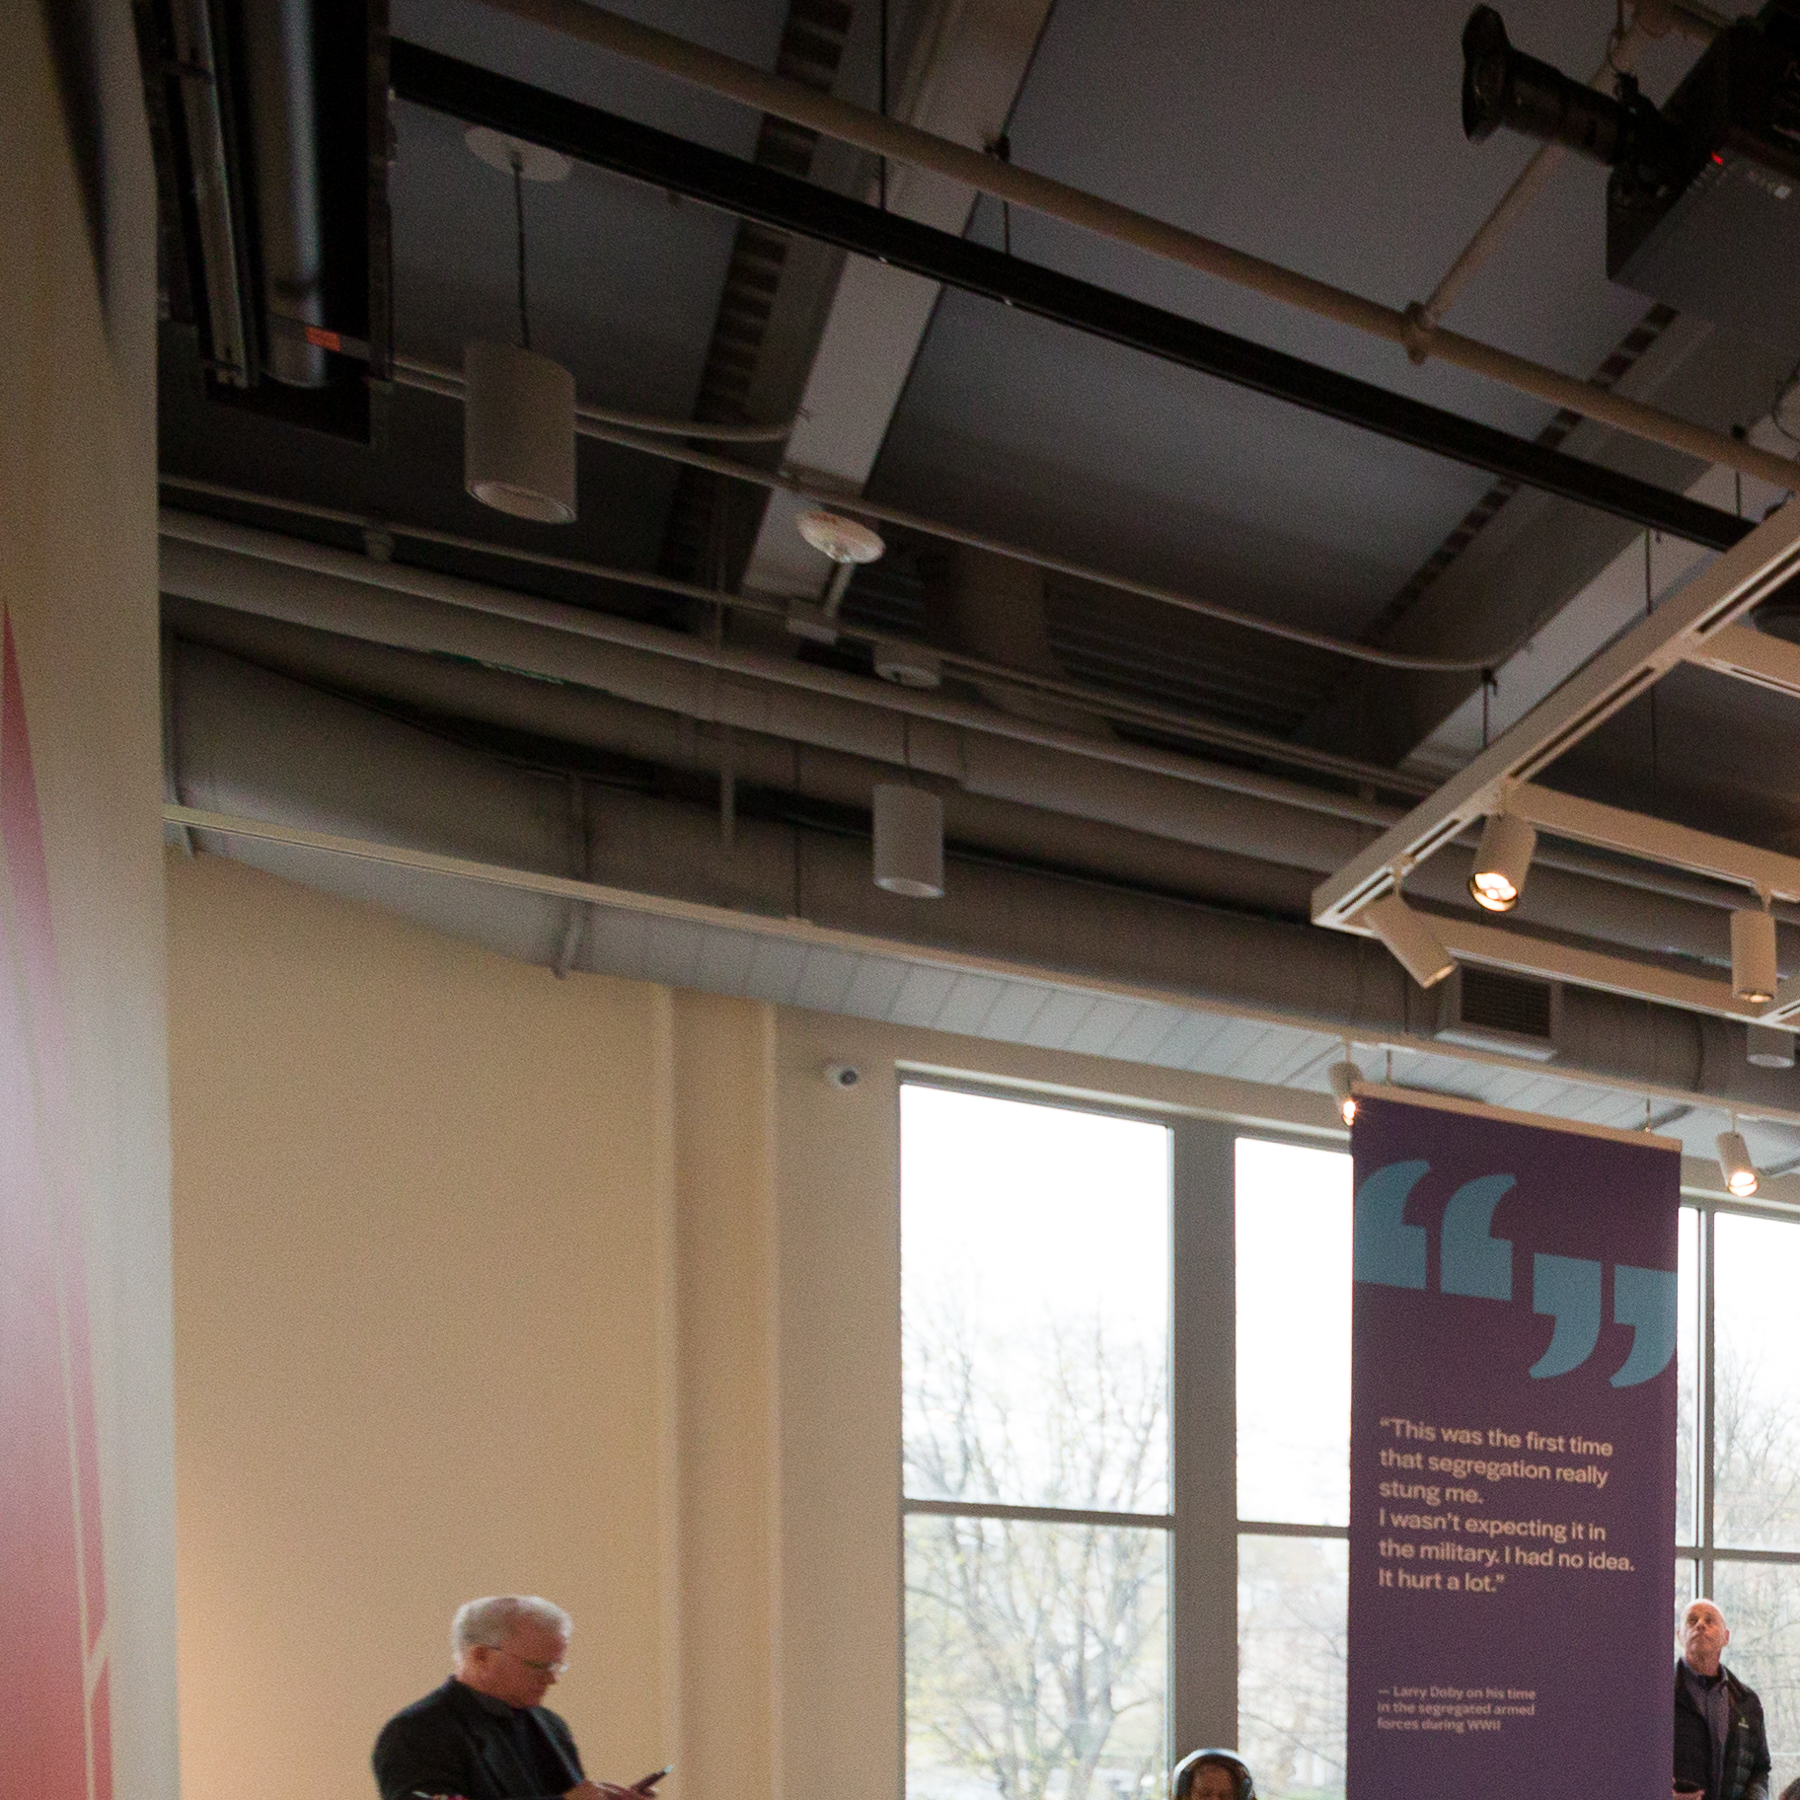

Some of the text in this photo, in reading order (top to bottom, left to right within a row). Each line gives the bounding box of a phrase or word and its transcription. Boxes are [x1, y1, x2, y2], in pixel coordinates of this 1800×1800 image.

[1441, 1427, 1483, 1446] was
[1488, 1429, 1521, 1449] the
[1526, 1431, 1565, 1452] first
[1569, 1436, 1613, 1457] time
[1379, 1449, 1608, 1489] that segregation really
[1379, 1481, 1484, 1506] stung me.
[1379, 1508, 1606, 1543] I wasn't expecting it in
[1379, 1538, 1635, 1572] the military. I had no idea.
[1379, 1568, 1392, 1587] It
[1398, 1569, 1442, 1589] hurt
[1447, 1575, 1460, 1590] a
[1393, 1686, 1427, 1700] Larry
[1430, 1686, 1463, 1700] Doby
[1466, 1688, 1483, 1698] on
[1486, 1687, 1504, 1699] his
[1508, 1689, 1536, 1700] time
[1378, 1702, 1535, 1717] in the segregated armed
[1378, 1717, 1419, 1730] forces
[1422, 1718, 1464, 1733] during
